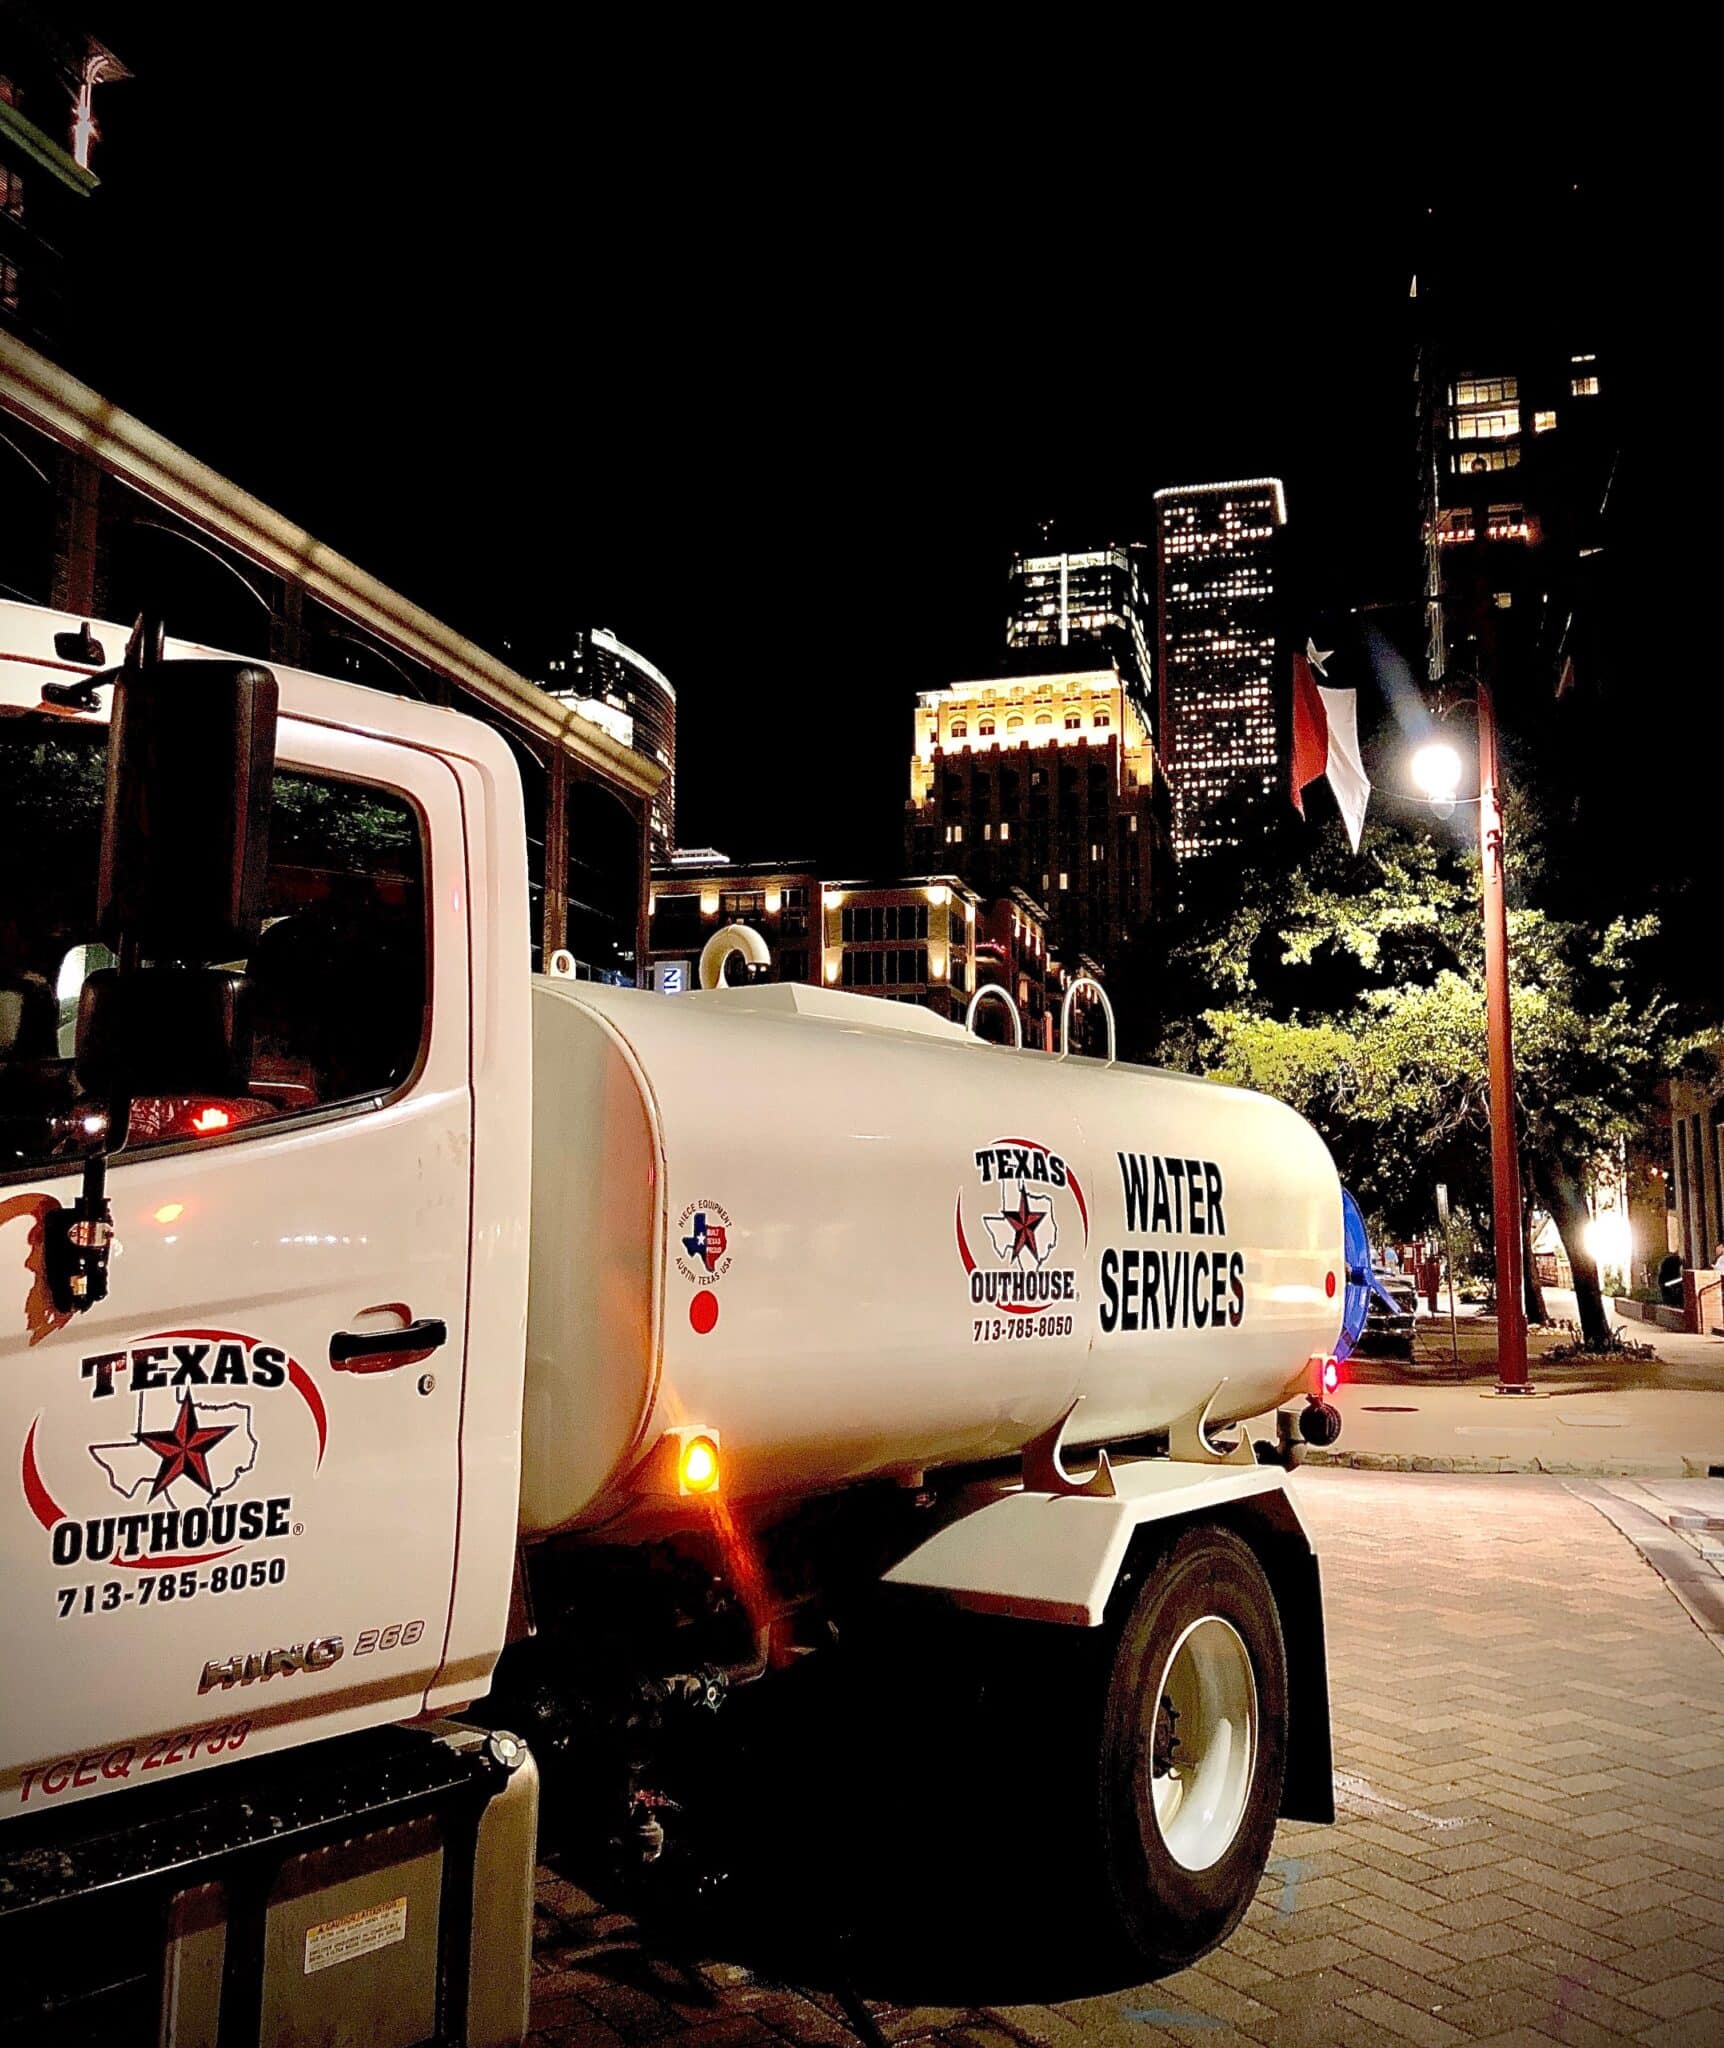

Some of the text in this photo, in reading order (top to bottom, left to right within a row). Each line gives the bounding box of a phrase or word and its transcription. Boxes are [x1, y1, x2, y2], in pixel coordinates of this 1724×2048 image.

[975, 1149, 1067, 1187] TEXAS
[1117, 1152, 1225, 1236] WATER
[678, 1200, 732, 1228] NIECE EQUIPMENT
[676, 1257, 732, 1285] AUSTIN TEXAS USA
[971, 1271, 1074, 1303] OUTHOUSE
[1100, 1249, 1244, 1333] SERVICES
[973, 1316, 1072, 1341] 713-785-8050
[81, 1343, 287, 1398] TEXAS
[51, 1498, 292, 1566] OUTHOUSE
[57, 1558, 286, 1618] 713-785-8050
[197, 1620, 424, 1695] HINO 268
[19, 1719, 251, 1802] TCEQ 22739
